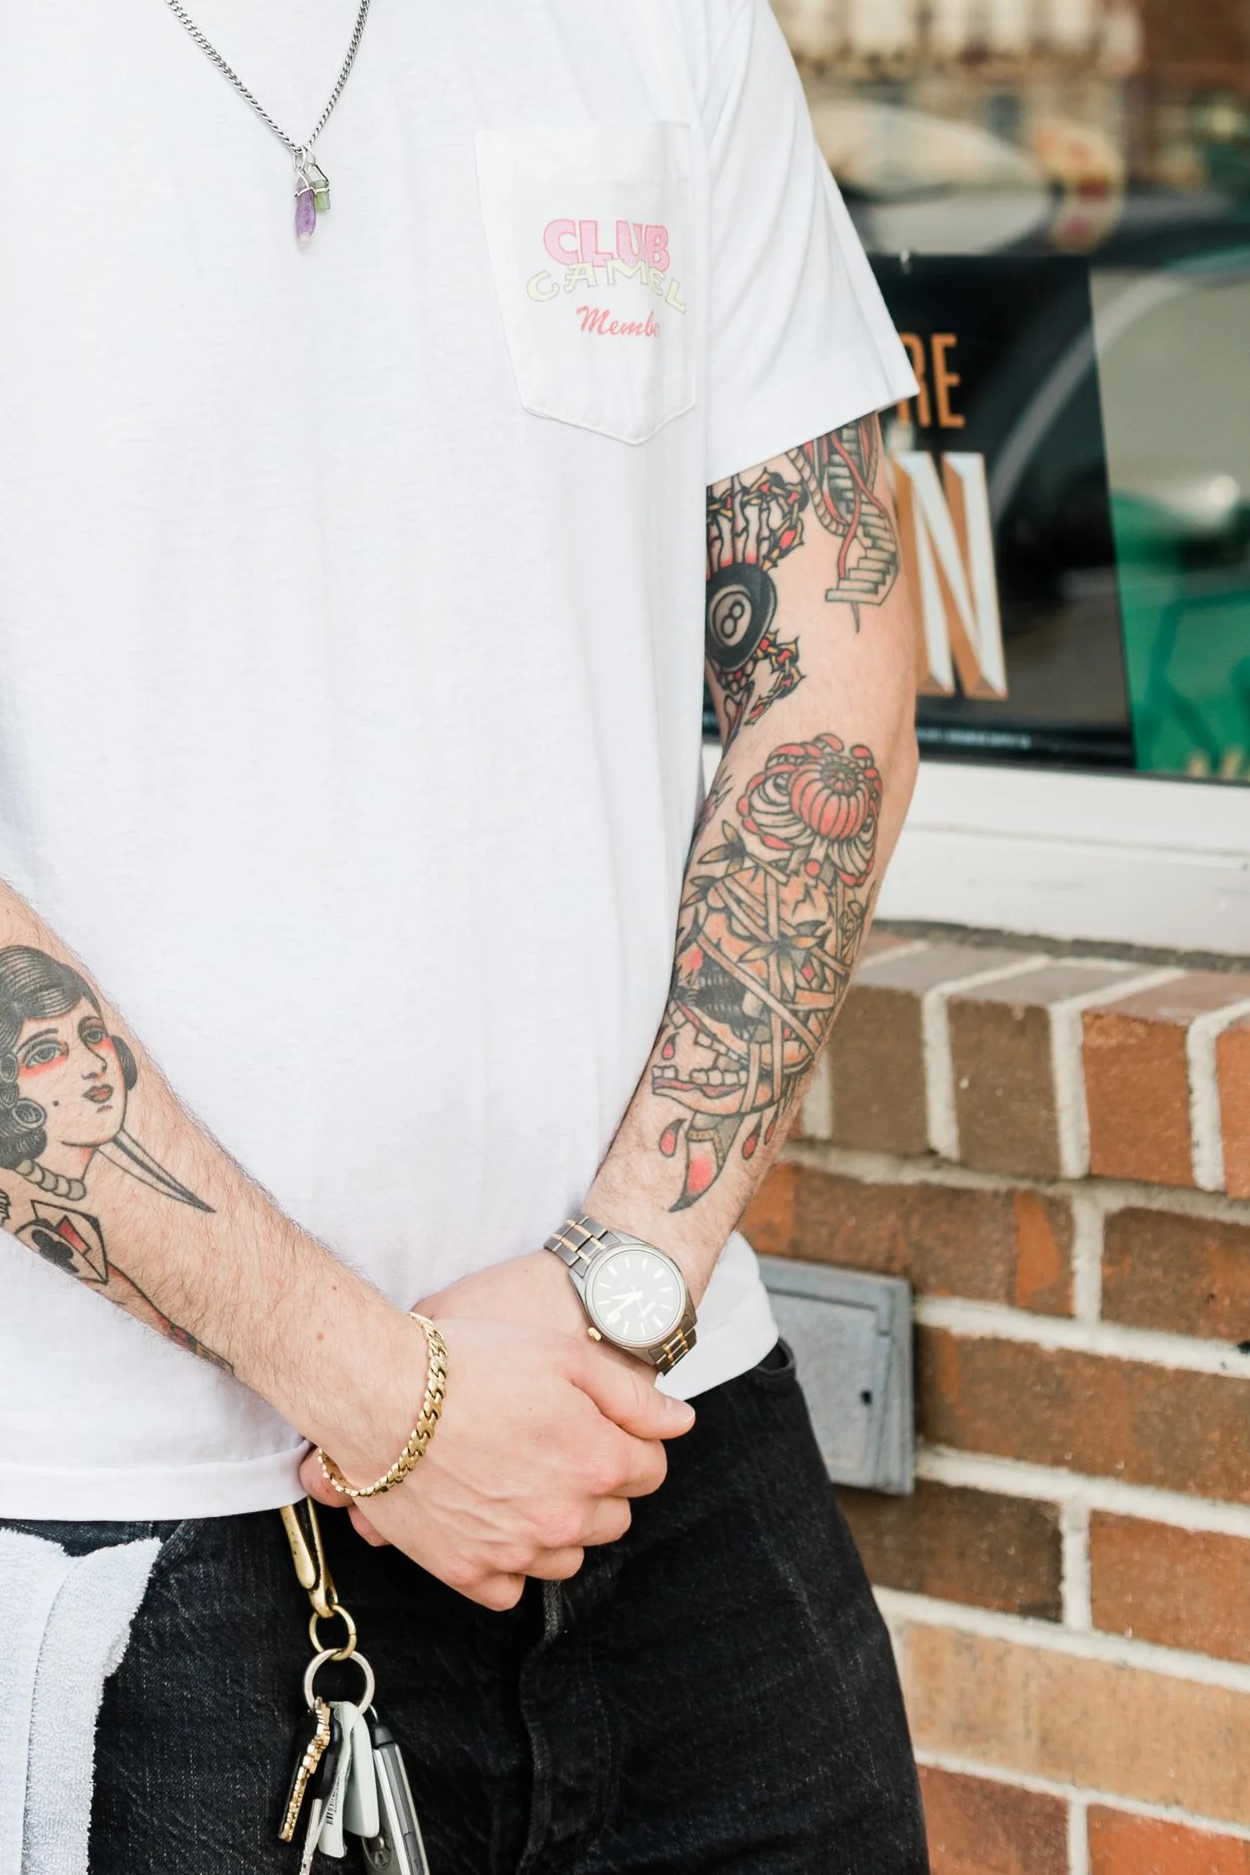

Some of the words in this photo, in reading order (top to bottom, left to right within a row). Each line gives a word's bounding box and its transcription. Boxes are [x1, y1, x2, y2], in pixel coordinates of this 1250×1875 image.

[543, 219, 671, 271] CLUB
[526, 258, 686, 315] CAMEL
[721, 600, 745, 639] 8
